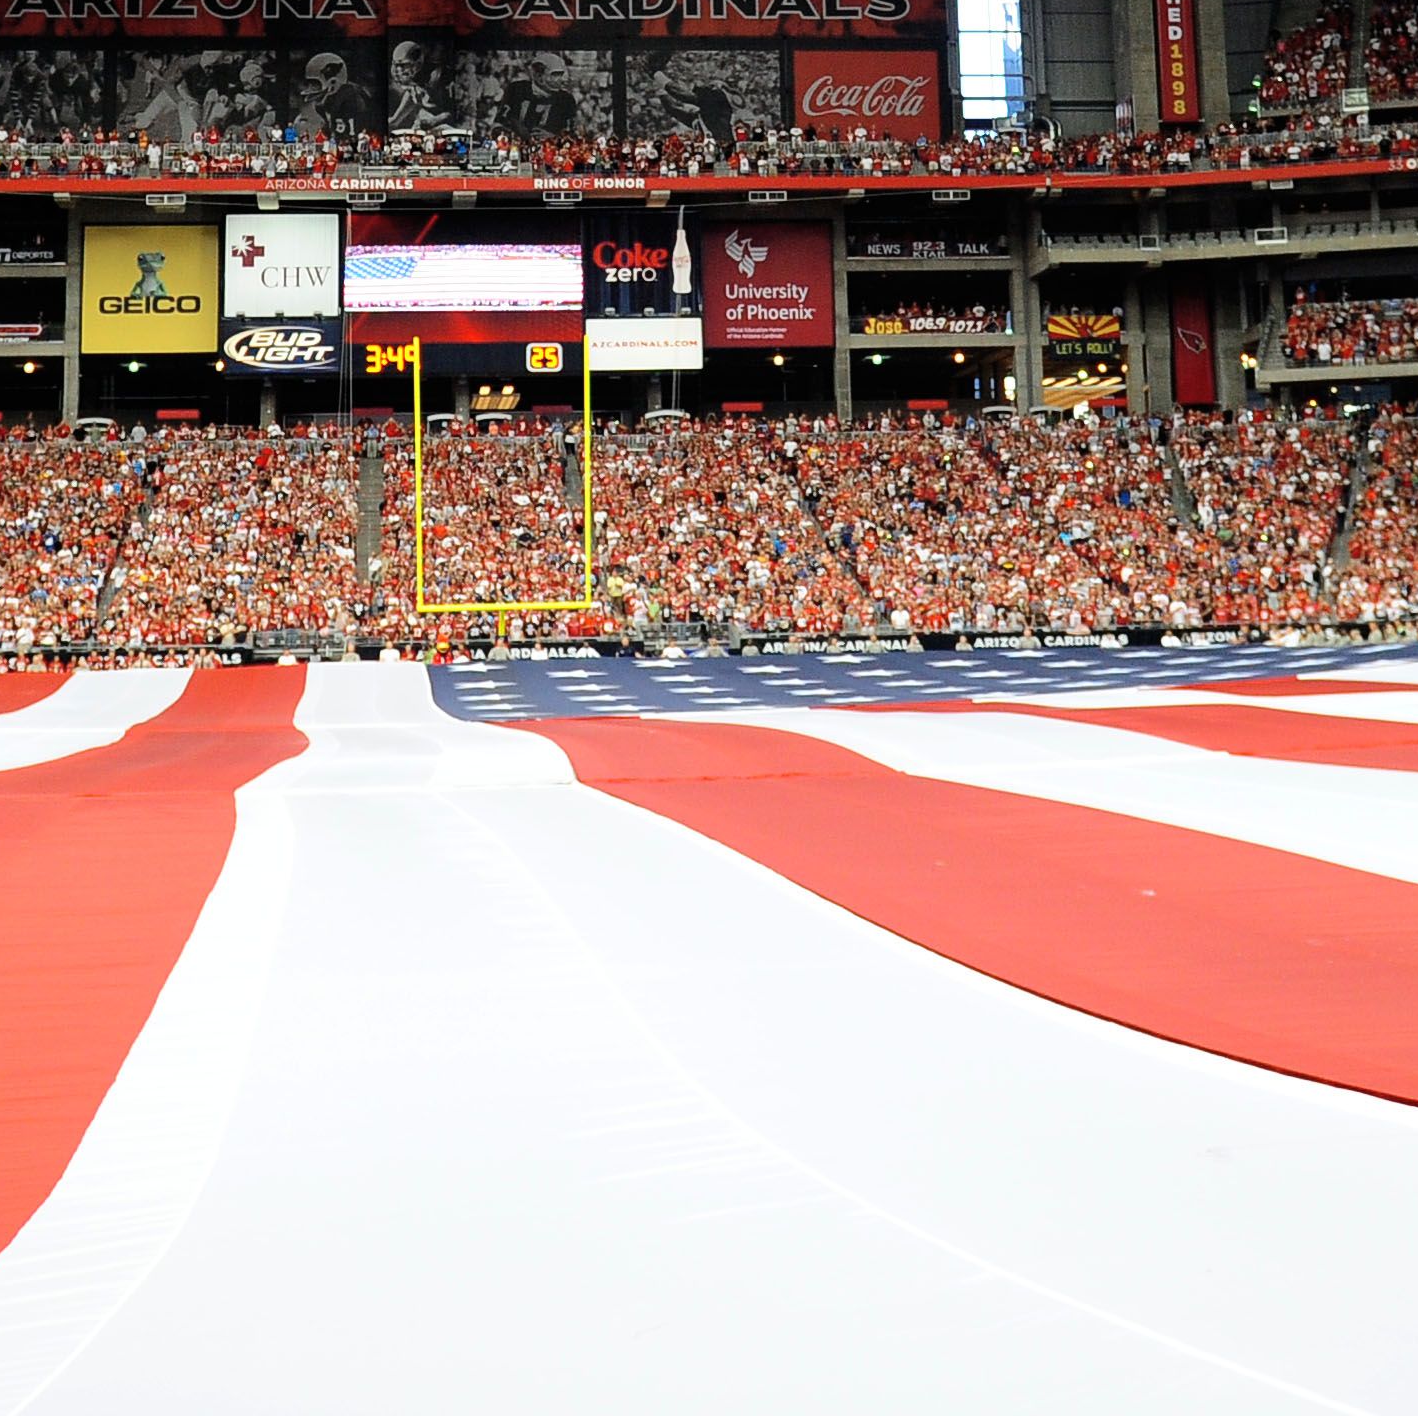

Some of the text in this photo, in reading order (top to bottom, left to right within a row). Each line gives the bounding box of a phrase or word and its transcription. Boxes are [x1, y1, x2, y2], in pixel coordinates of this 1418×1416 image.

[1170, 44, 1186, 115] 1898
[264, 179, 414, 190] ARIZONA CARDINALS
[534, 179, 645, 189] RING OF HONOR
[593, 240, 669, 269] Coke
[867, 244, 901, 255] NEWS
[958, 243, 989, 254] TALK
[261, 266, 332, 288] CHW
[605, 266, 657, 282] zero
[725, 283, 809, 303] University
[98, 295, 201, 315] GEICO
[726, 304, 814, 320] of Phoenix
[249, 331, 322, 347] BUD
[592, 340, 698, 348] AZCARDINALS.COM
[236, 346, 334, 362] LIGHT
[1044, 634, 1129, 647] CARDINS
